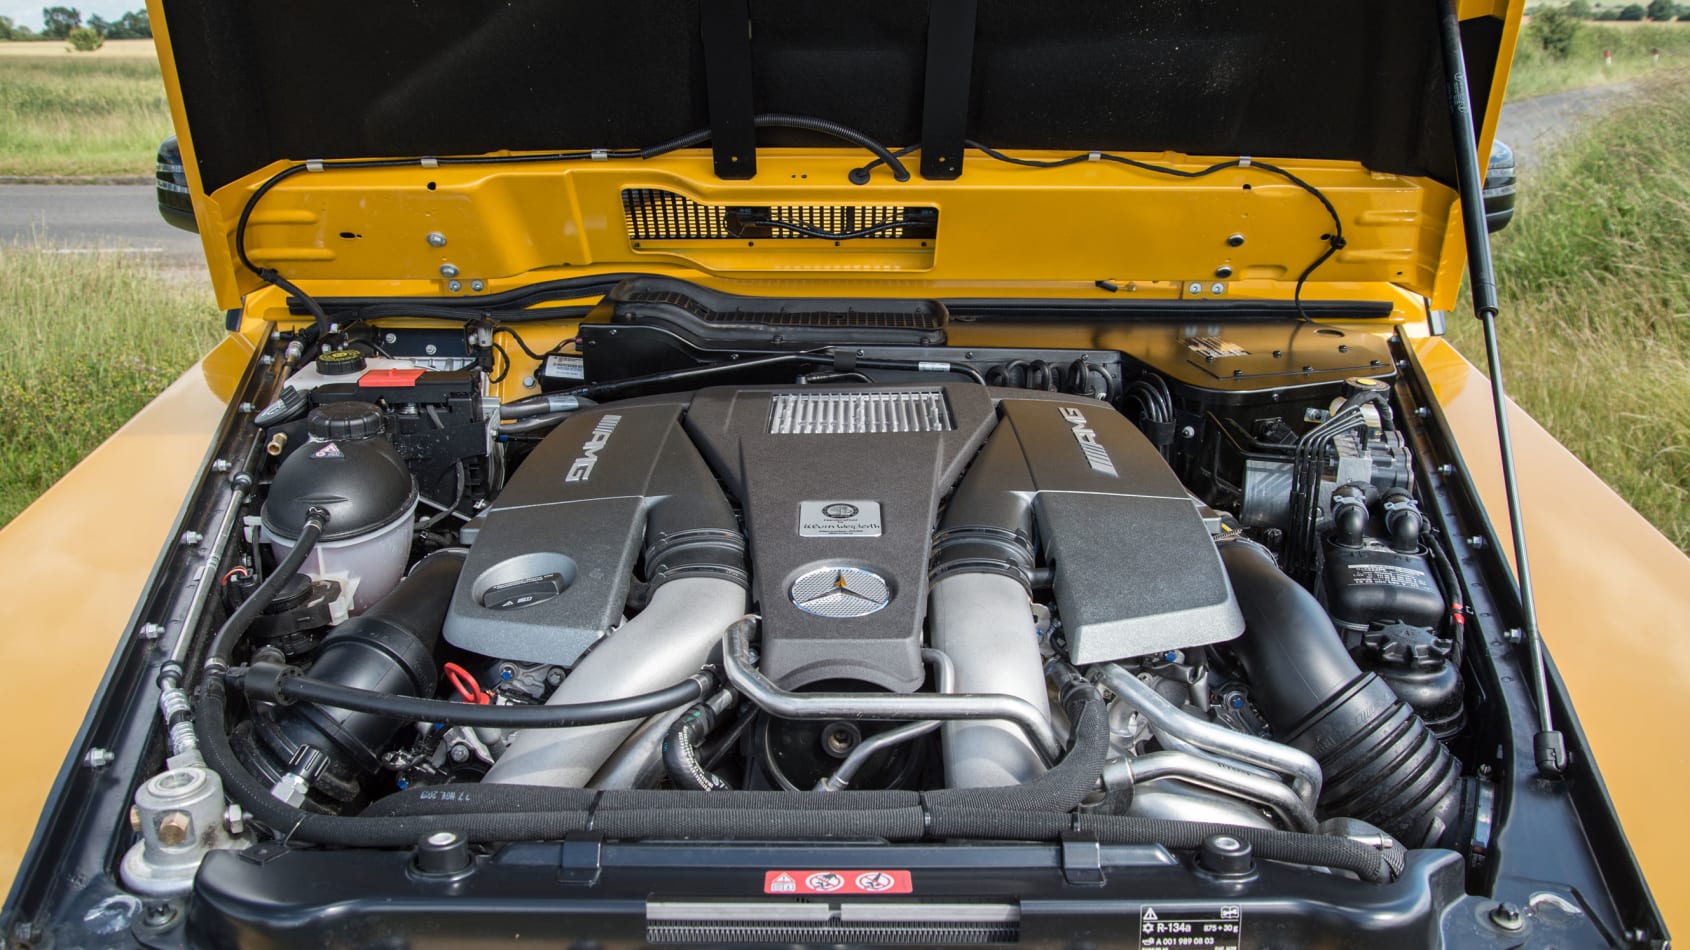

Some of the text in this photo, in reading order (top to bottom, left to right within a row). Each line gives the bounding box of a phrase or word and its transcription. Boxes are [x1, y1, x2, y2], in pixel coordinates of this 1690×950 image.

[1058, 407, 1104, 449] AMG
[565, 431, 612, 482] AMG
[1157, 923, 1192, 933] R-134a
